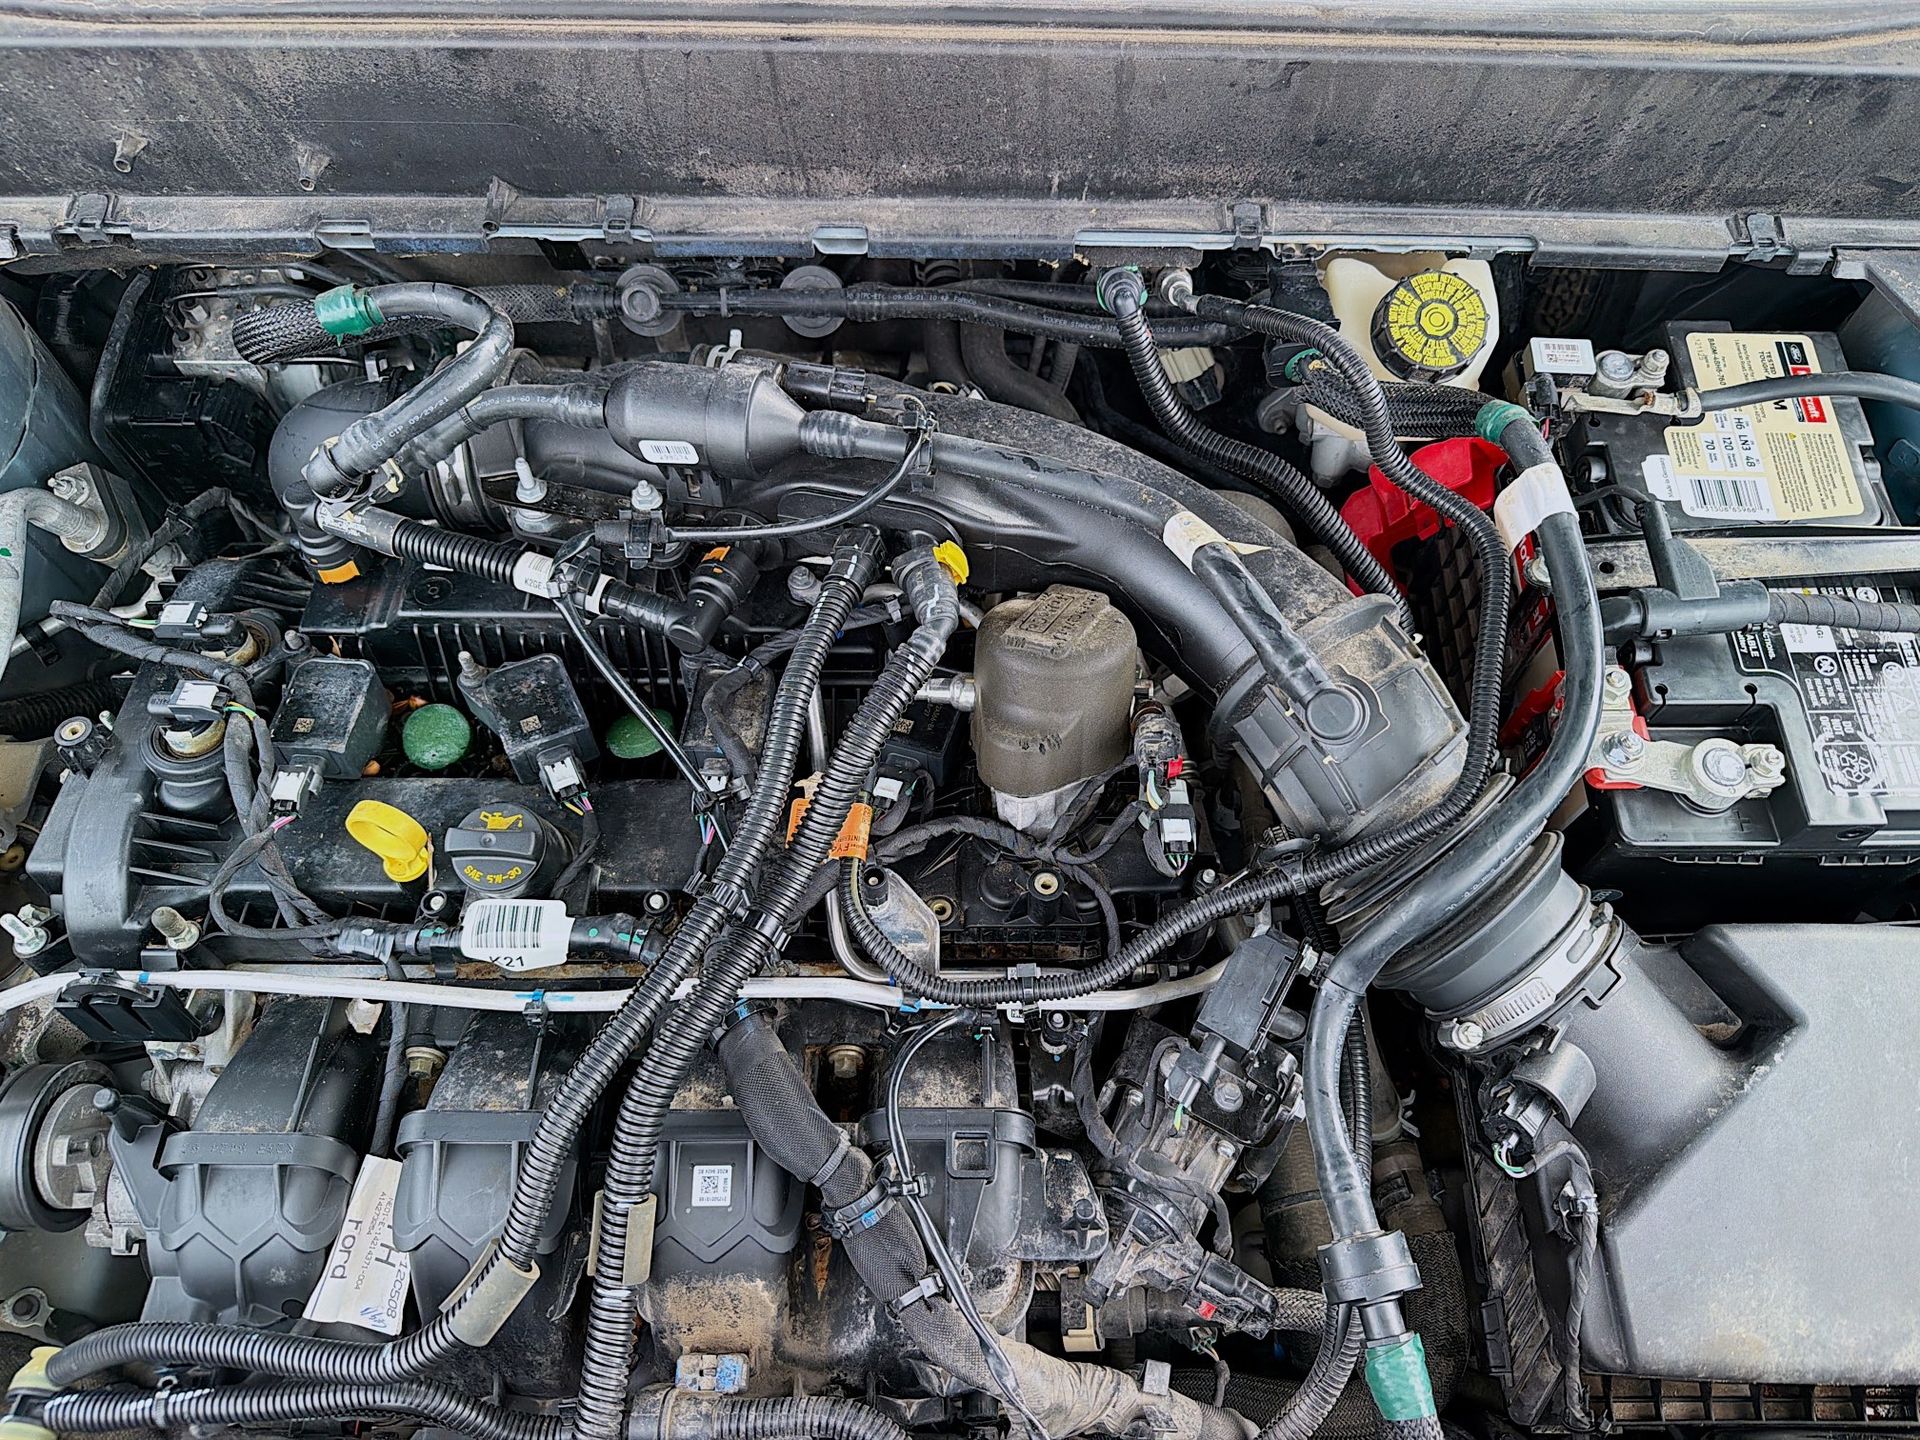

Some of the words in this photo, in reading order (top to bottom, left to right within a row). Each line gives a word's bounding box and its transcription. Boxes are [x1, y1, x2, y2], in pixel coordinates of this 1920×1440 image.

[371, 437, 387, 451] DOT
[408, 397, 449, 425] 09/29/21
[1734, 418, 1745, 428] H6
[1704, 440, 1716, 449] 70
[1722, 438, 1734, 450] 120
[1738, 435, 1752, 450] LN3
[1744, 456, 1756, 466] 48
[1830, 720, 1844, 736] NOT
[1842, 723, 1854, 732] DO
[464, 865, 483, 882] SAE
[486, 867, 522, 884] 5W-30
[330, 1219, 363, 1279] Ford
[374, 1242, 400, 1268] H
